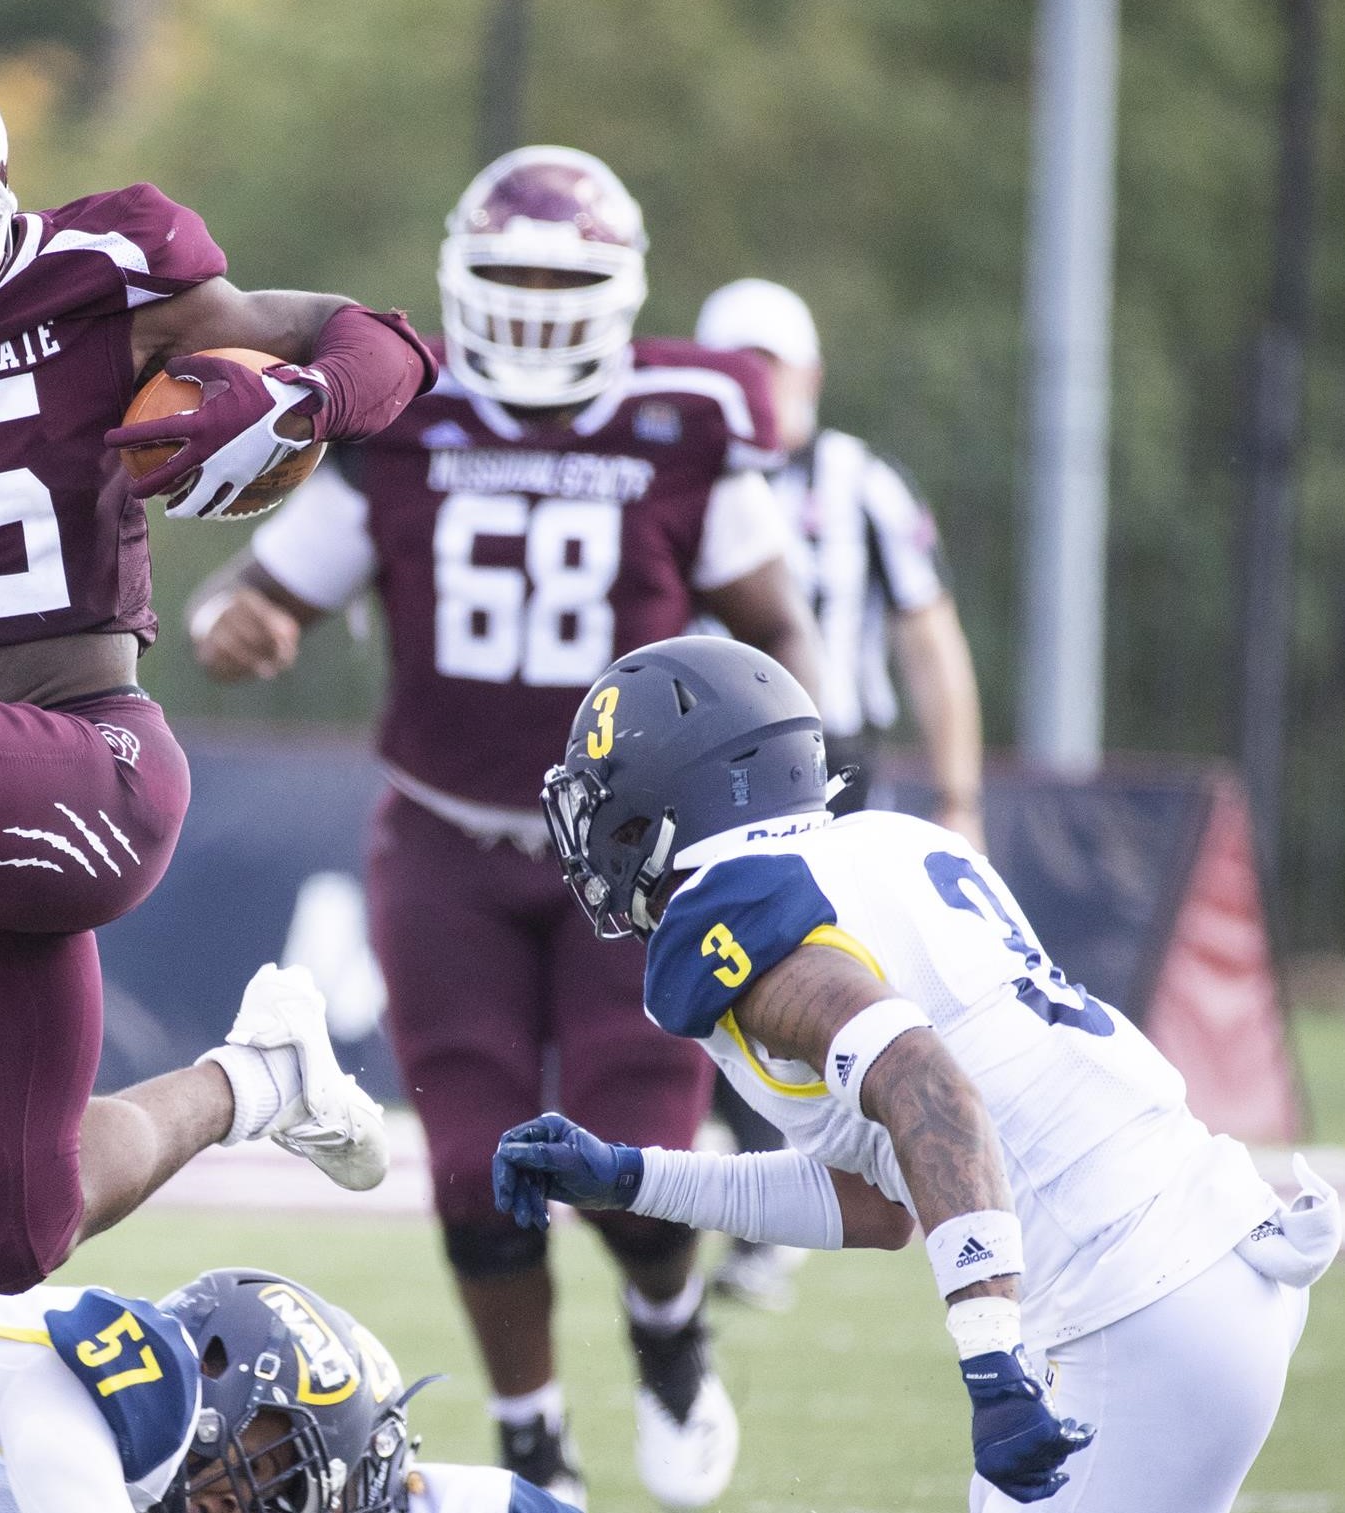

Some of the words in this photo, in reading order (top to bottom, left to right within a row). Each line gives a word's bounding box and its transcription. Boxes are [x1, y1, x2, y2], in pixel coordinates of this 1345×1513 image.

[433, 494, 623, 688] 68
[587, 686, 620, 759] 3
[701, 922, 752, 988] 3
[923, 851, 1116, 1038] 3
[955, 1250, 994, 1268] adidas
[76, 1309, 164, 1397] 57
